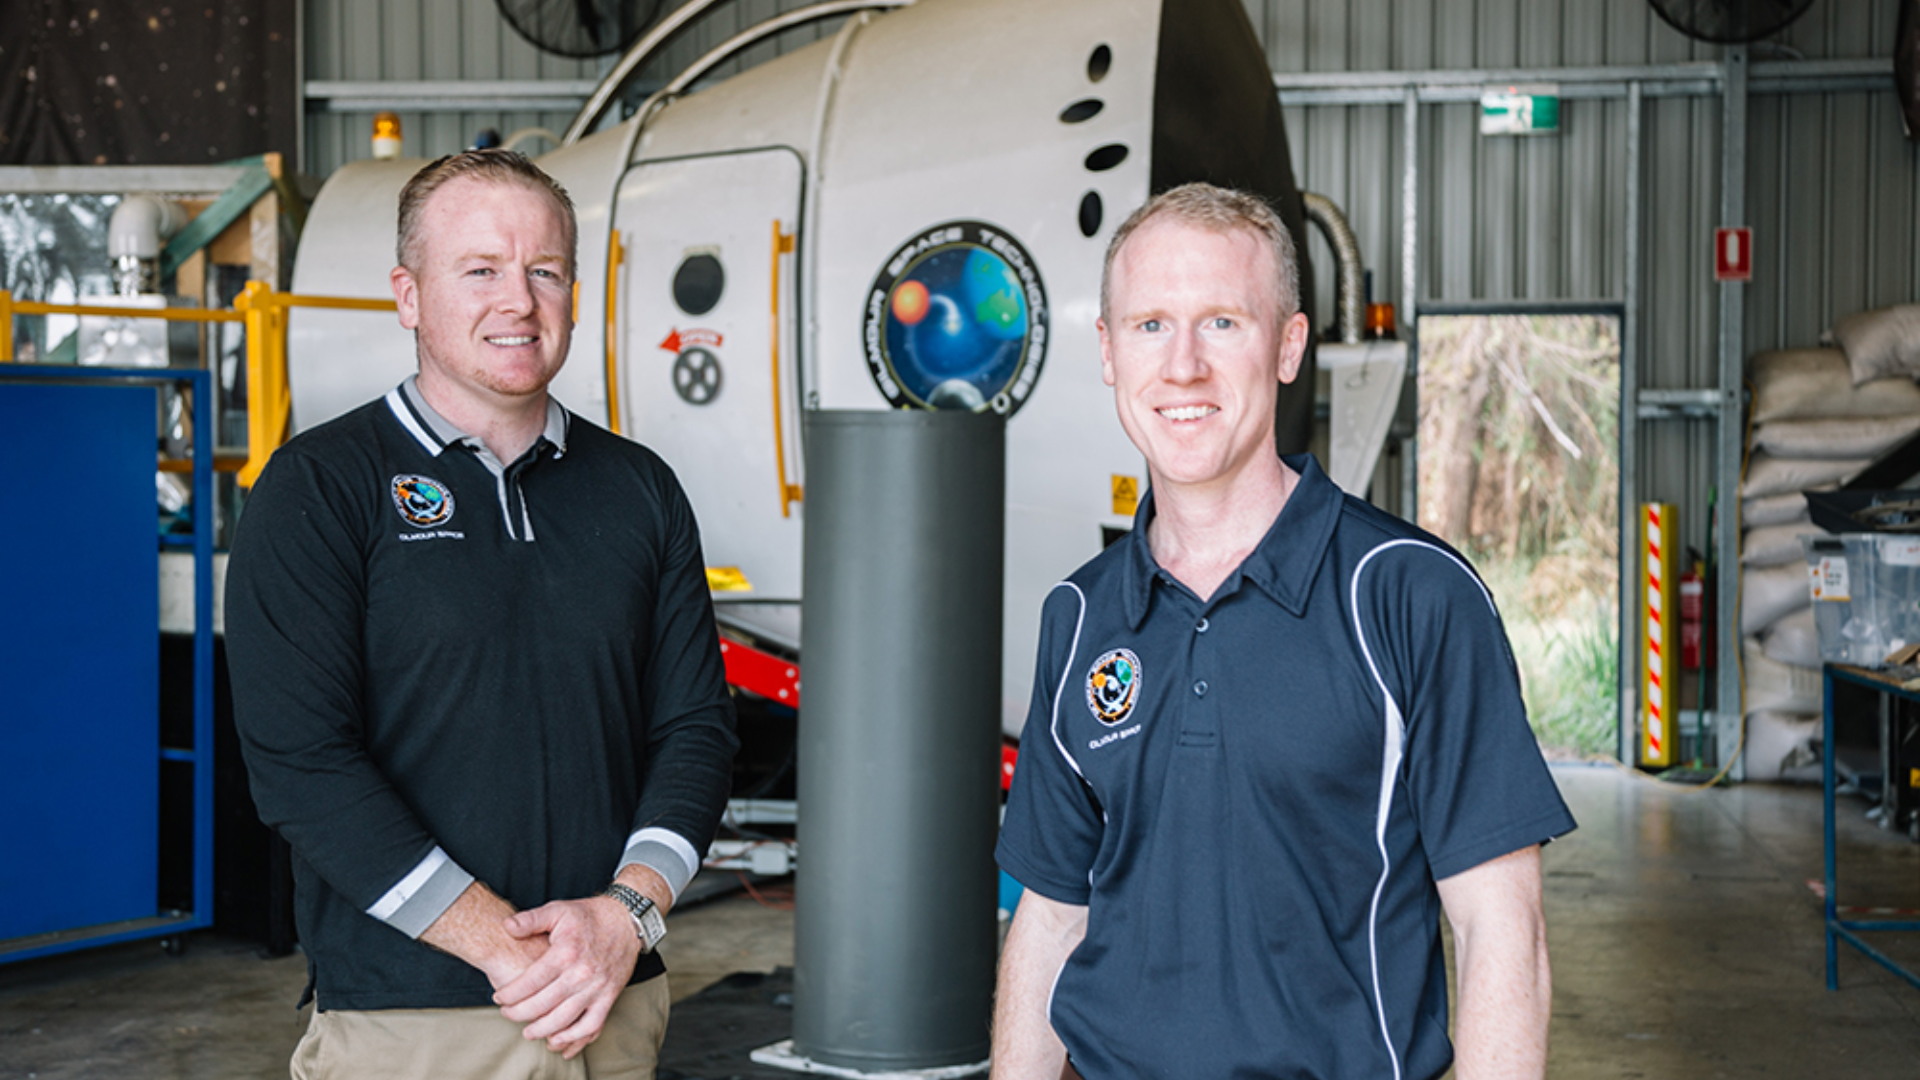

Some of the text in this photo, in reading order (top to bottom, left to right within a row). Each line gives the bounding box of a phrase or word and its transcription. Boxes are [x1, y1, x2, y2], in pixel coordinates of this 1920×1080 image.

[866, 226, 1046, 400] GILMOUR SPACE TECHNOLOGIES
